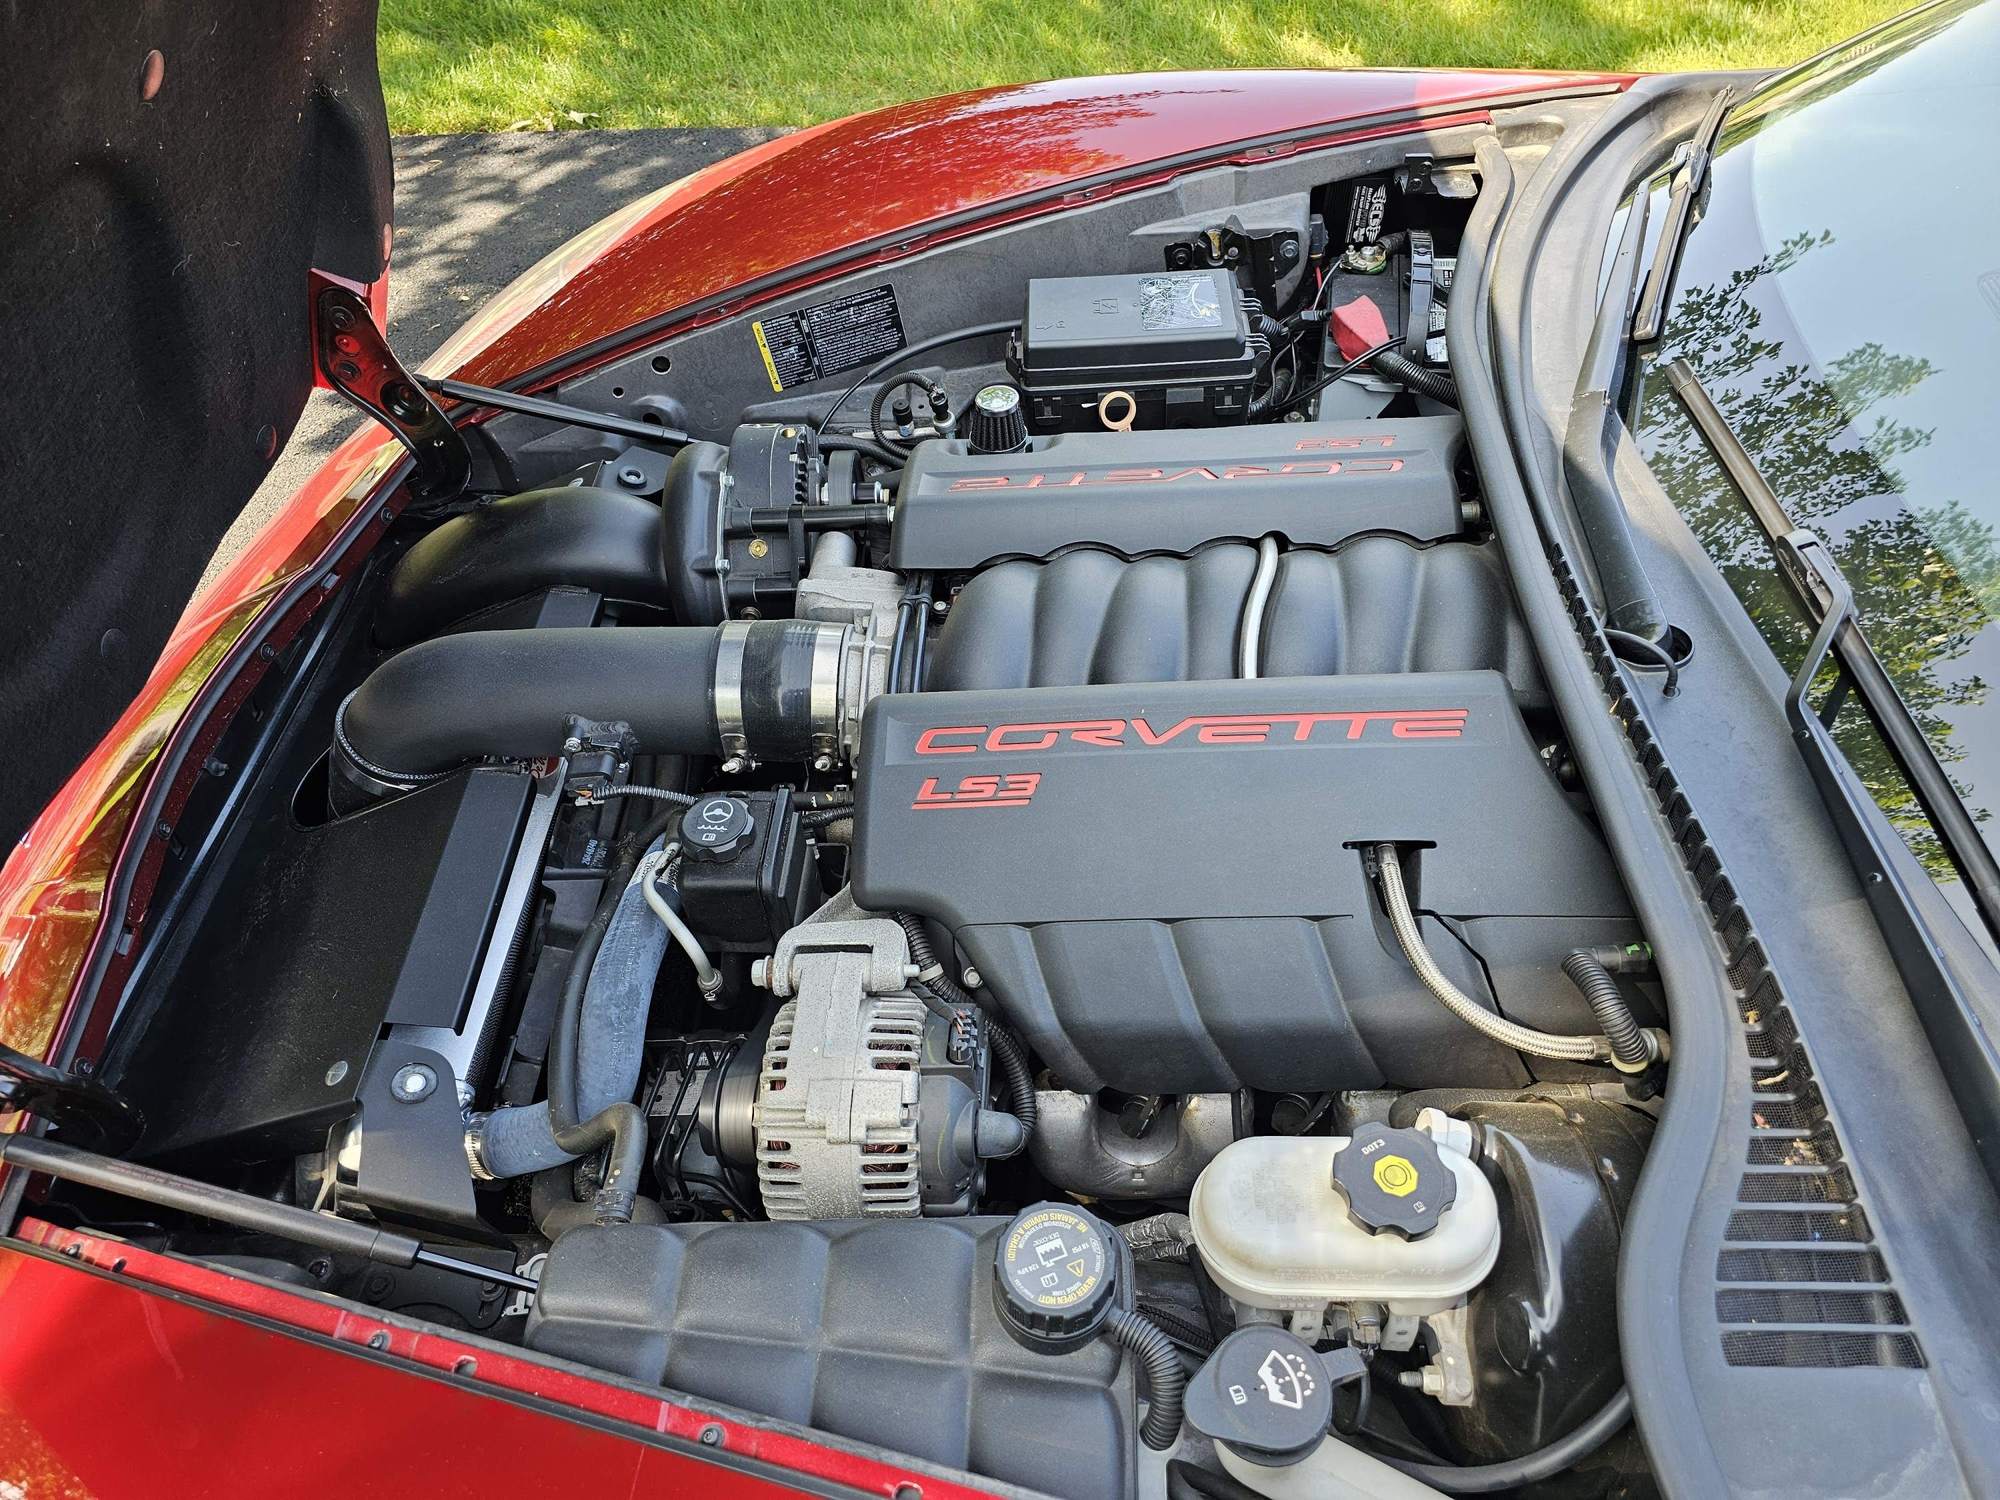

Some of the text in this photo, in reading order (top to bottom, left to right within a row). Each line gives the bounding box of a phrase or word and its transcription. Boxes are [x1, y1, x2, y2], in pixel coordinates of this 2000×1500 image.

[1295, 434, 1398, 450] LS3
[946, 458, 1405, 492] CORVETTE
[914, 709, 1468, 755] CORVETTE
[914, 772, 1041, 801] LS3
[1057, 1292, 1078, 1304] OPEN
[1077, 1276, 1096, 1296] NEVER
